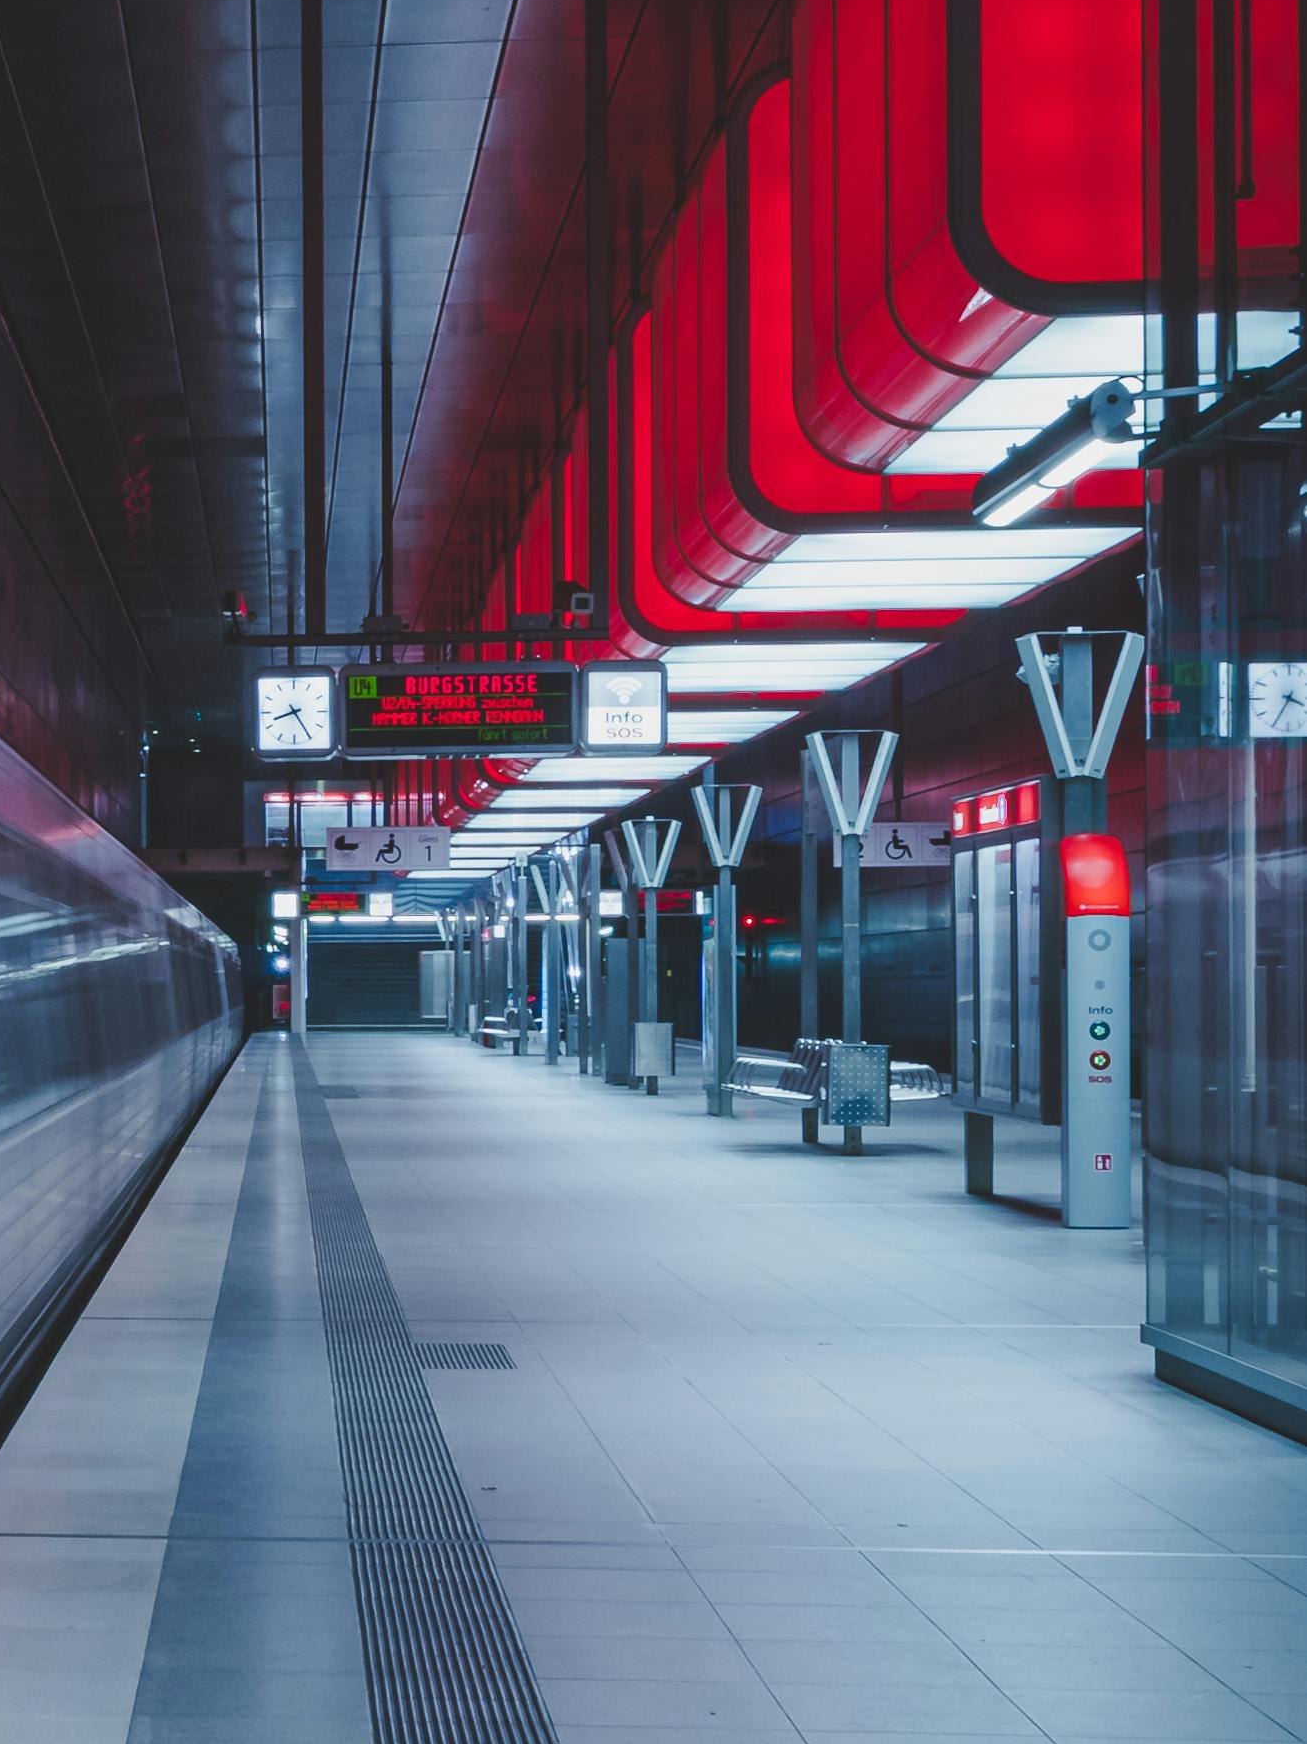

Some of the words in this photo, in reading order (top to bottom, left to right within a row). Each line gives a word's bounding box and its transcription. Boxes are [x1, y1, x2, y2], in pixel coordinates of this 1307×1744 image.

[353, 678, 372, 696] U4
[405, 673, 538, 695] BURGSTRASSE
[605, 711, 643, 724] Info
[606, 727, 643, 738] SOS
[424, 845, 432, 862] 1
[1088, 1006, 1114, 1015] Info
[1087, 1075, 1113, 1084] SOS
